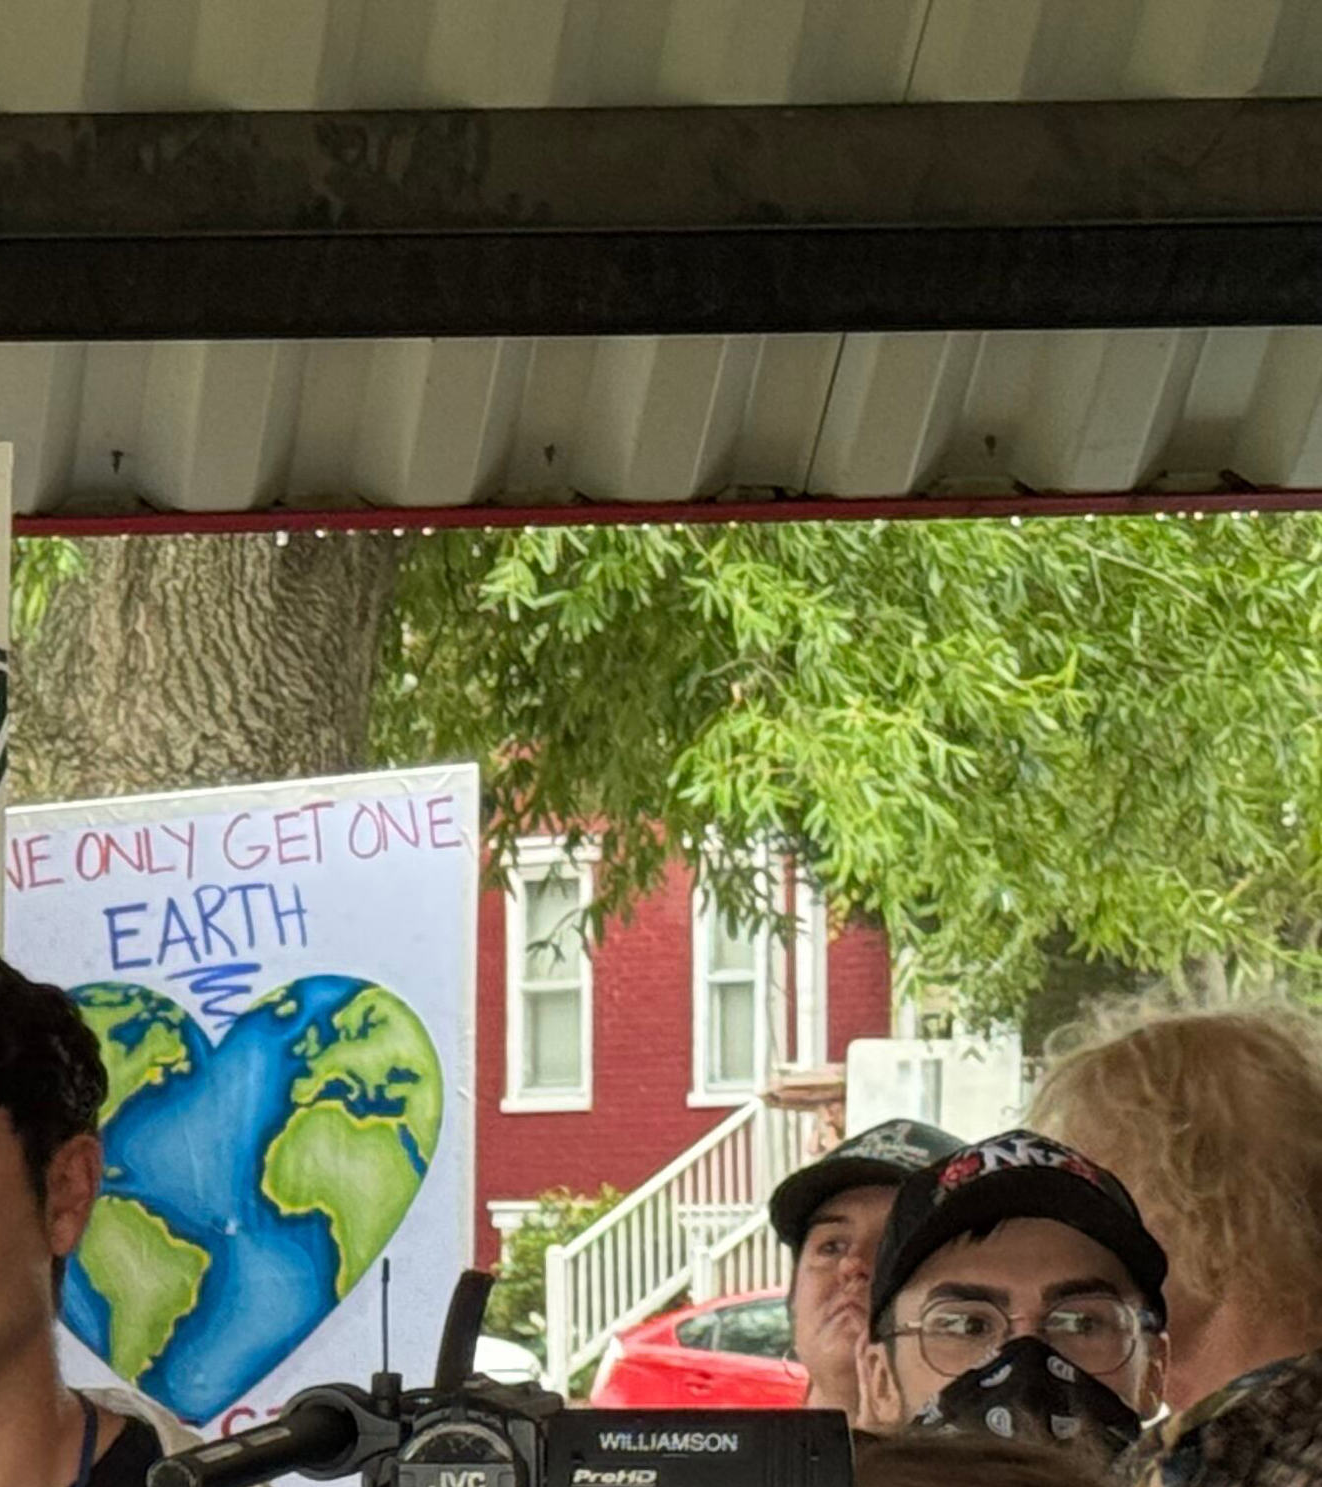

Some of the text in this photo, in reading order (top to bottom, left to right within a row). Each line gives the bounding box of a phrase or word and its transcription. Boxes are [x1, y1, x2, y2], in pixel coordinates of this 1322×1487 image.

[75, 822, 195, 880] ONLY
[223, 801, 336, 870] GET
[349, 796, 462, 860] ONE
[103, 884, 307, 970] EARTH
[599, 1432, 739, 1452] WILLIAMSON
[572, 1469, 657, 1484] ProHD
